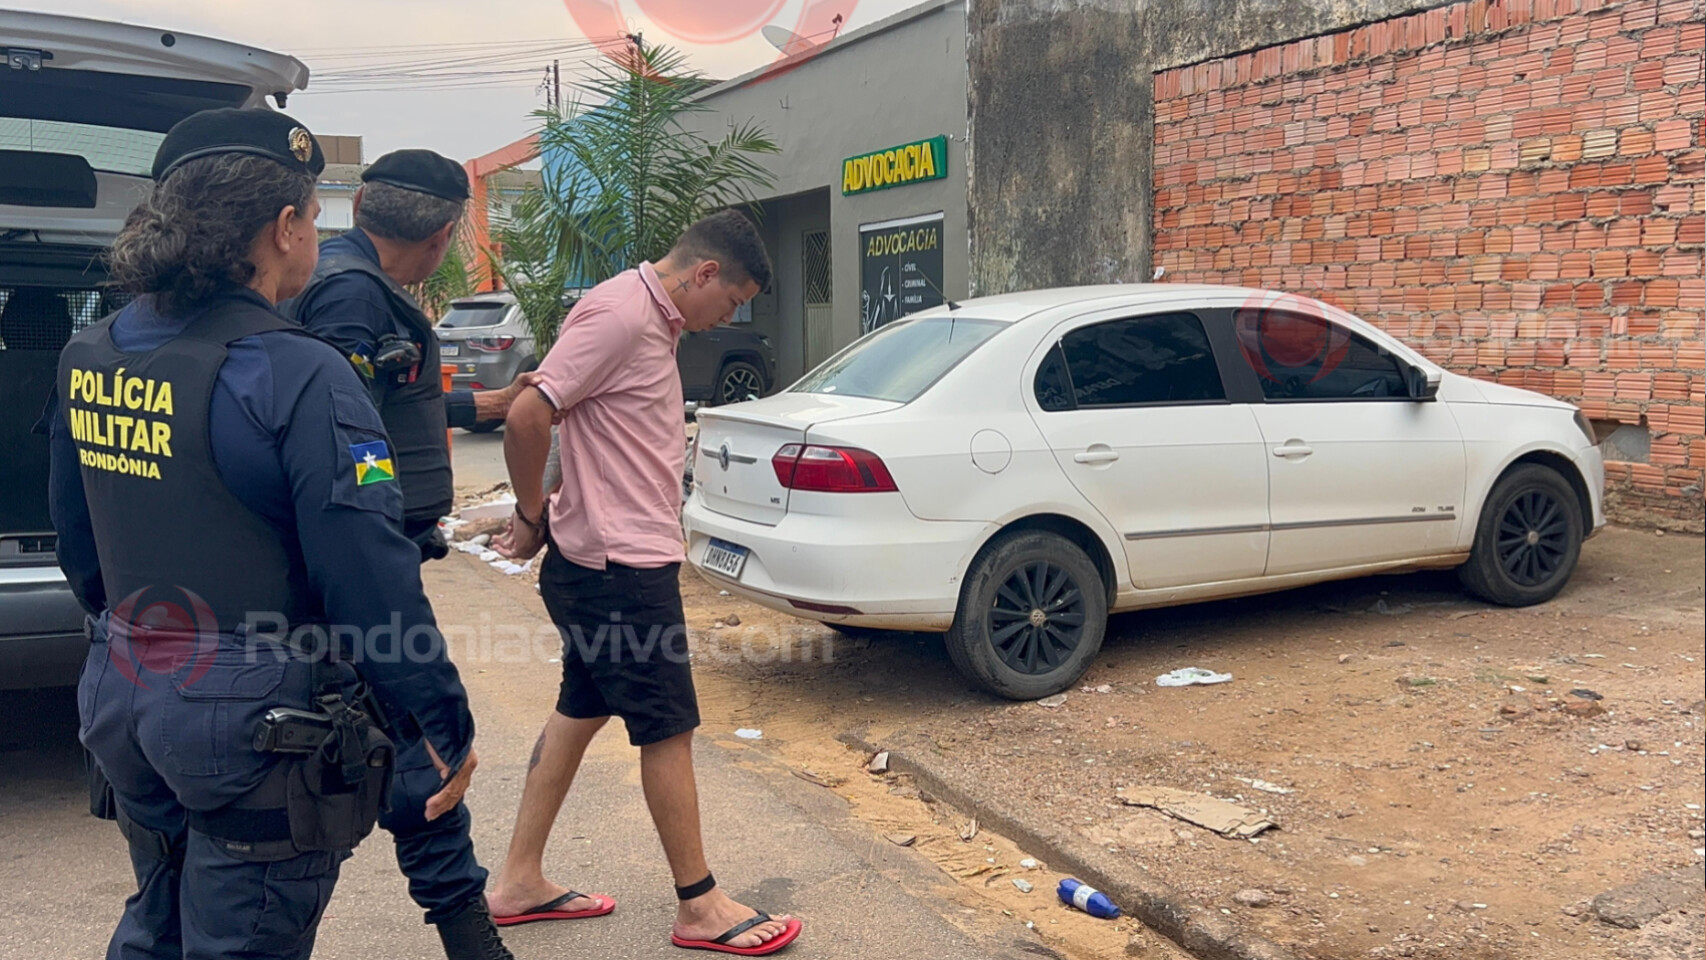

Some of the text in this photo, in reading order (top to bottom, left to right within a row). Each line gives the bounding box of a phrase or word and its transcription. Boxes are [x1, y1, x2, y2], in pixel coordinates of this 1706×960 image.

[843, 142, 935, 192] ADVOCACIA
[867, 227, 938, 257] ADVOCACIA
[70, 367, 174, 416] POLÍCIA
[70, 407, 173, 458] MILITAR
[80, 447, 162, 480] RONDÔNIA
